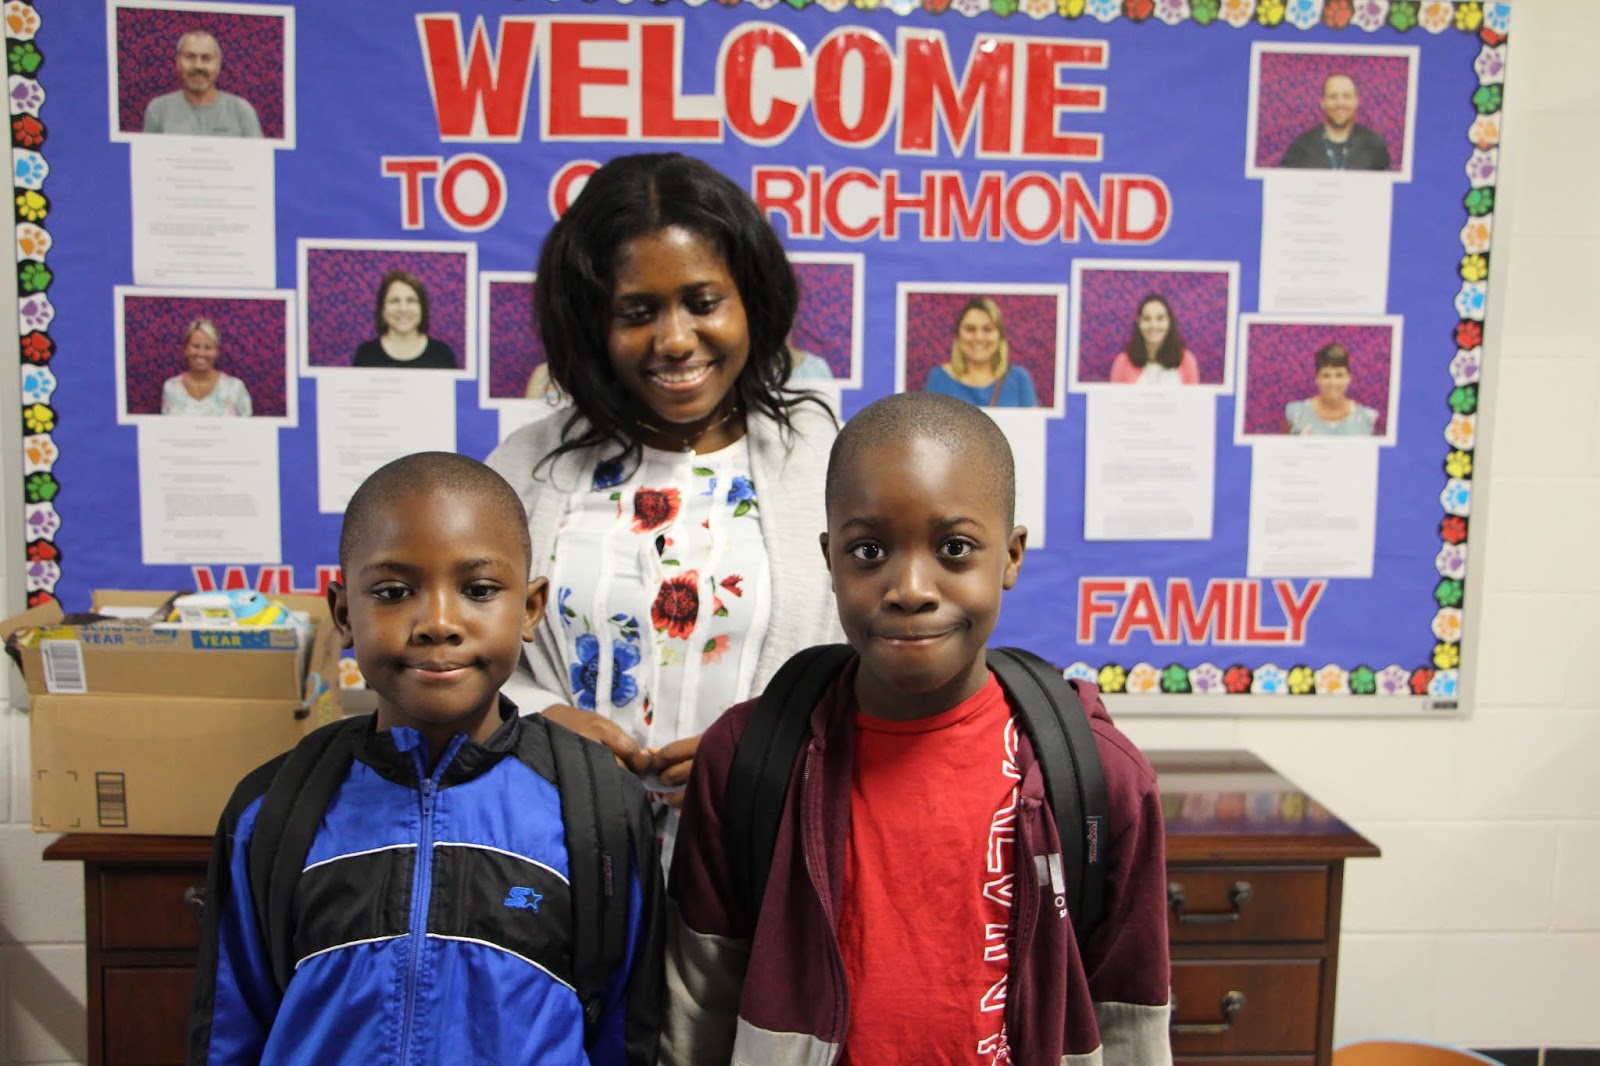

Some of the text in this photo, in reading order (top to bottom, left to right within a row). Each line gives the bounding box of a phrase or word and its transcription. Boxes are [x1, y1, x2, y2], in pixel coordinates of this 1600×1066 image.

[417, 13, 1109, 161] WELCOME
[380, 153, 507, 232] TO
[751, 164, 1172, 246] RICHMOND
[83, 633, 125, 645] YEAR
[199, 634, 242, 647] YEAR
[1076, 577, 1327, 646] FAMILY
